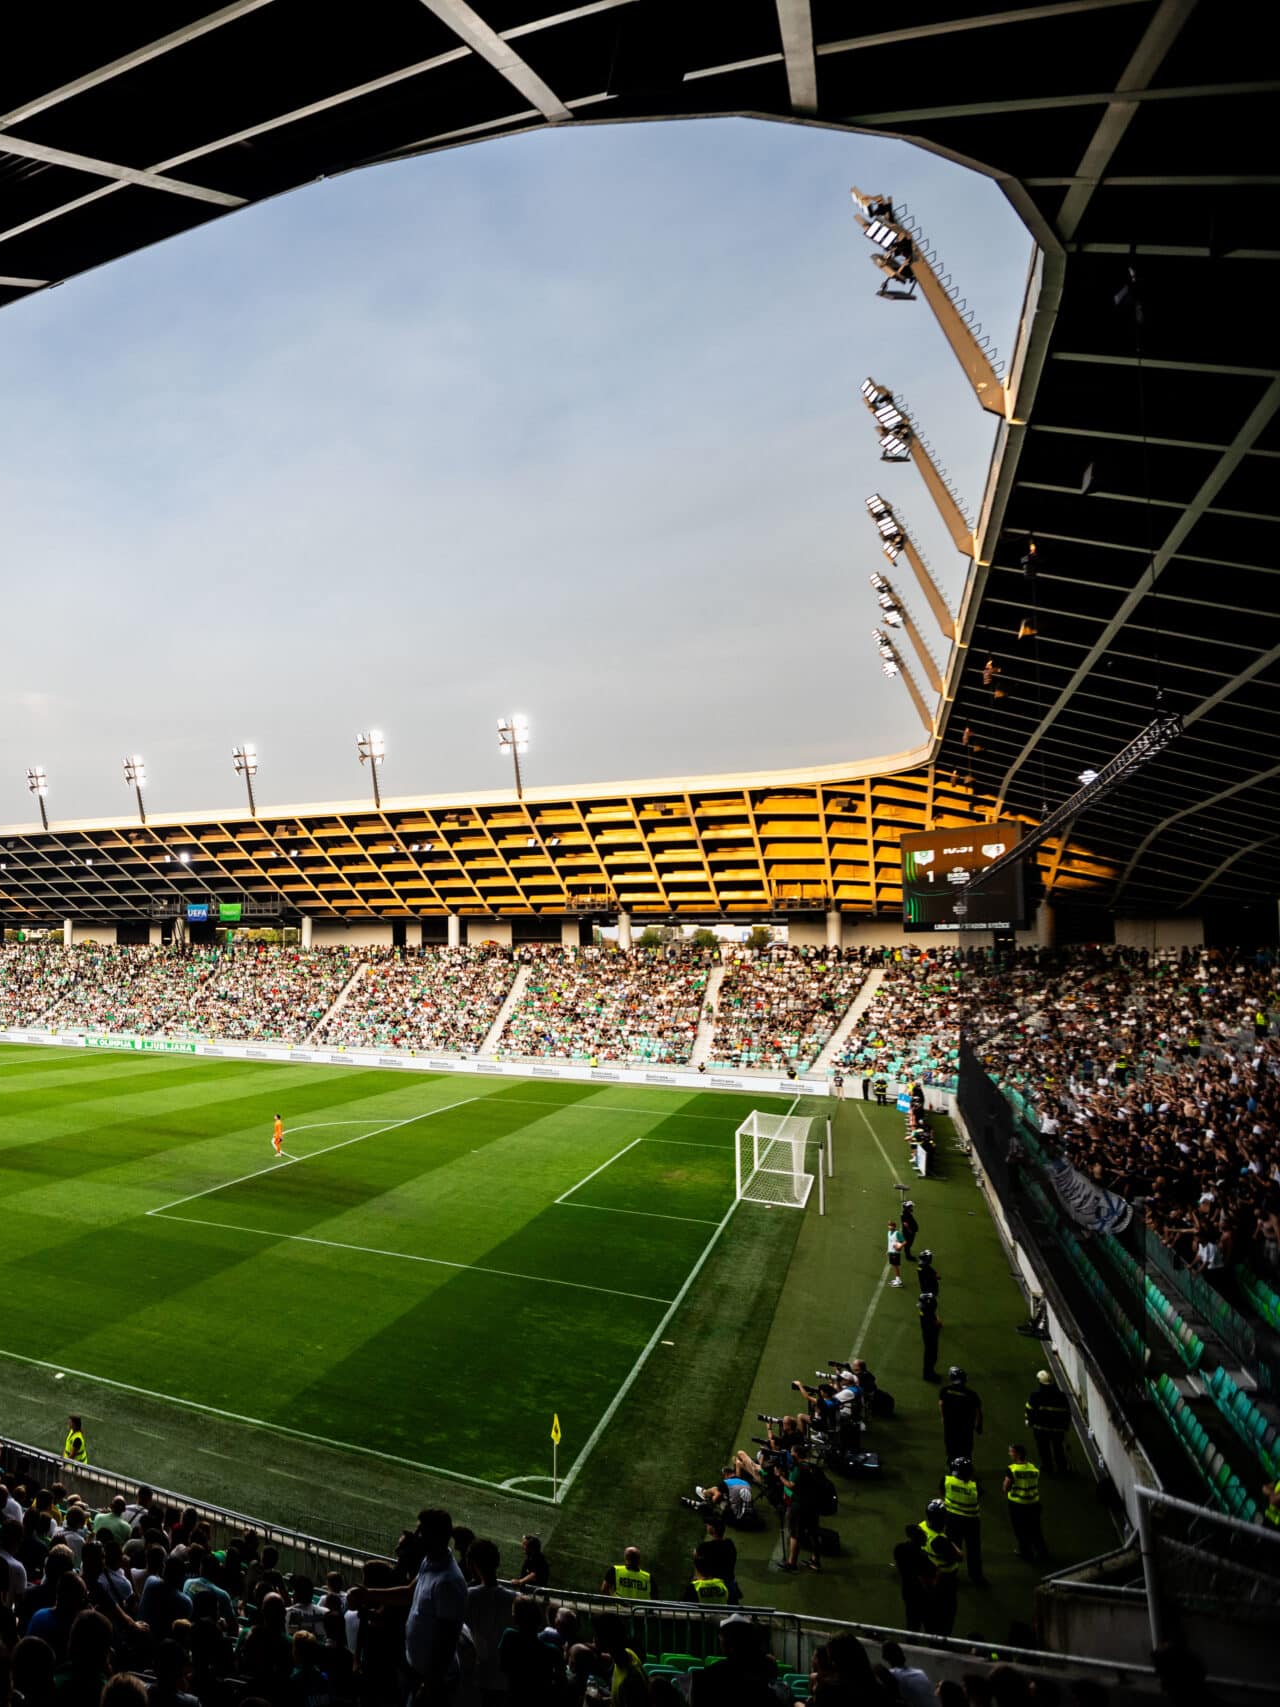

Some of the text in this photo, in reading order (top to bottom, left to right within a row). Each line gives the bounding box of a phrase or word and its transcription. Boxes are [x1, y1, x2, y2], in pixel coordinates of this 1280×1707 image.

[927, 871, 934, 883] 1
[187, 909, 207, 918] UEFA
[99, 1039, 131, 1047] OLIMPIJA
[144, 1041, 192, 1052] LJUBLJANA
